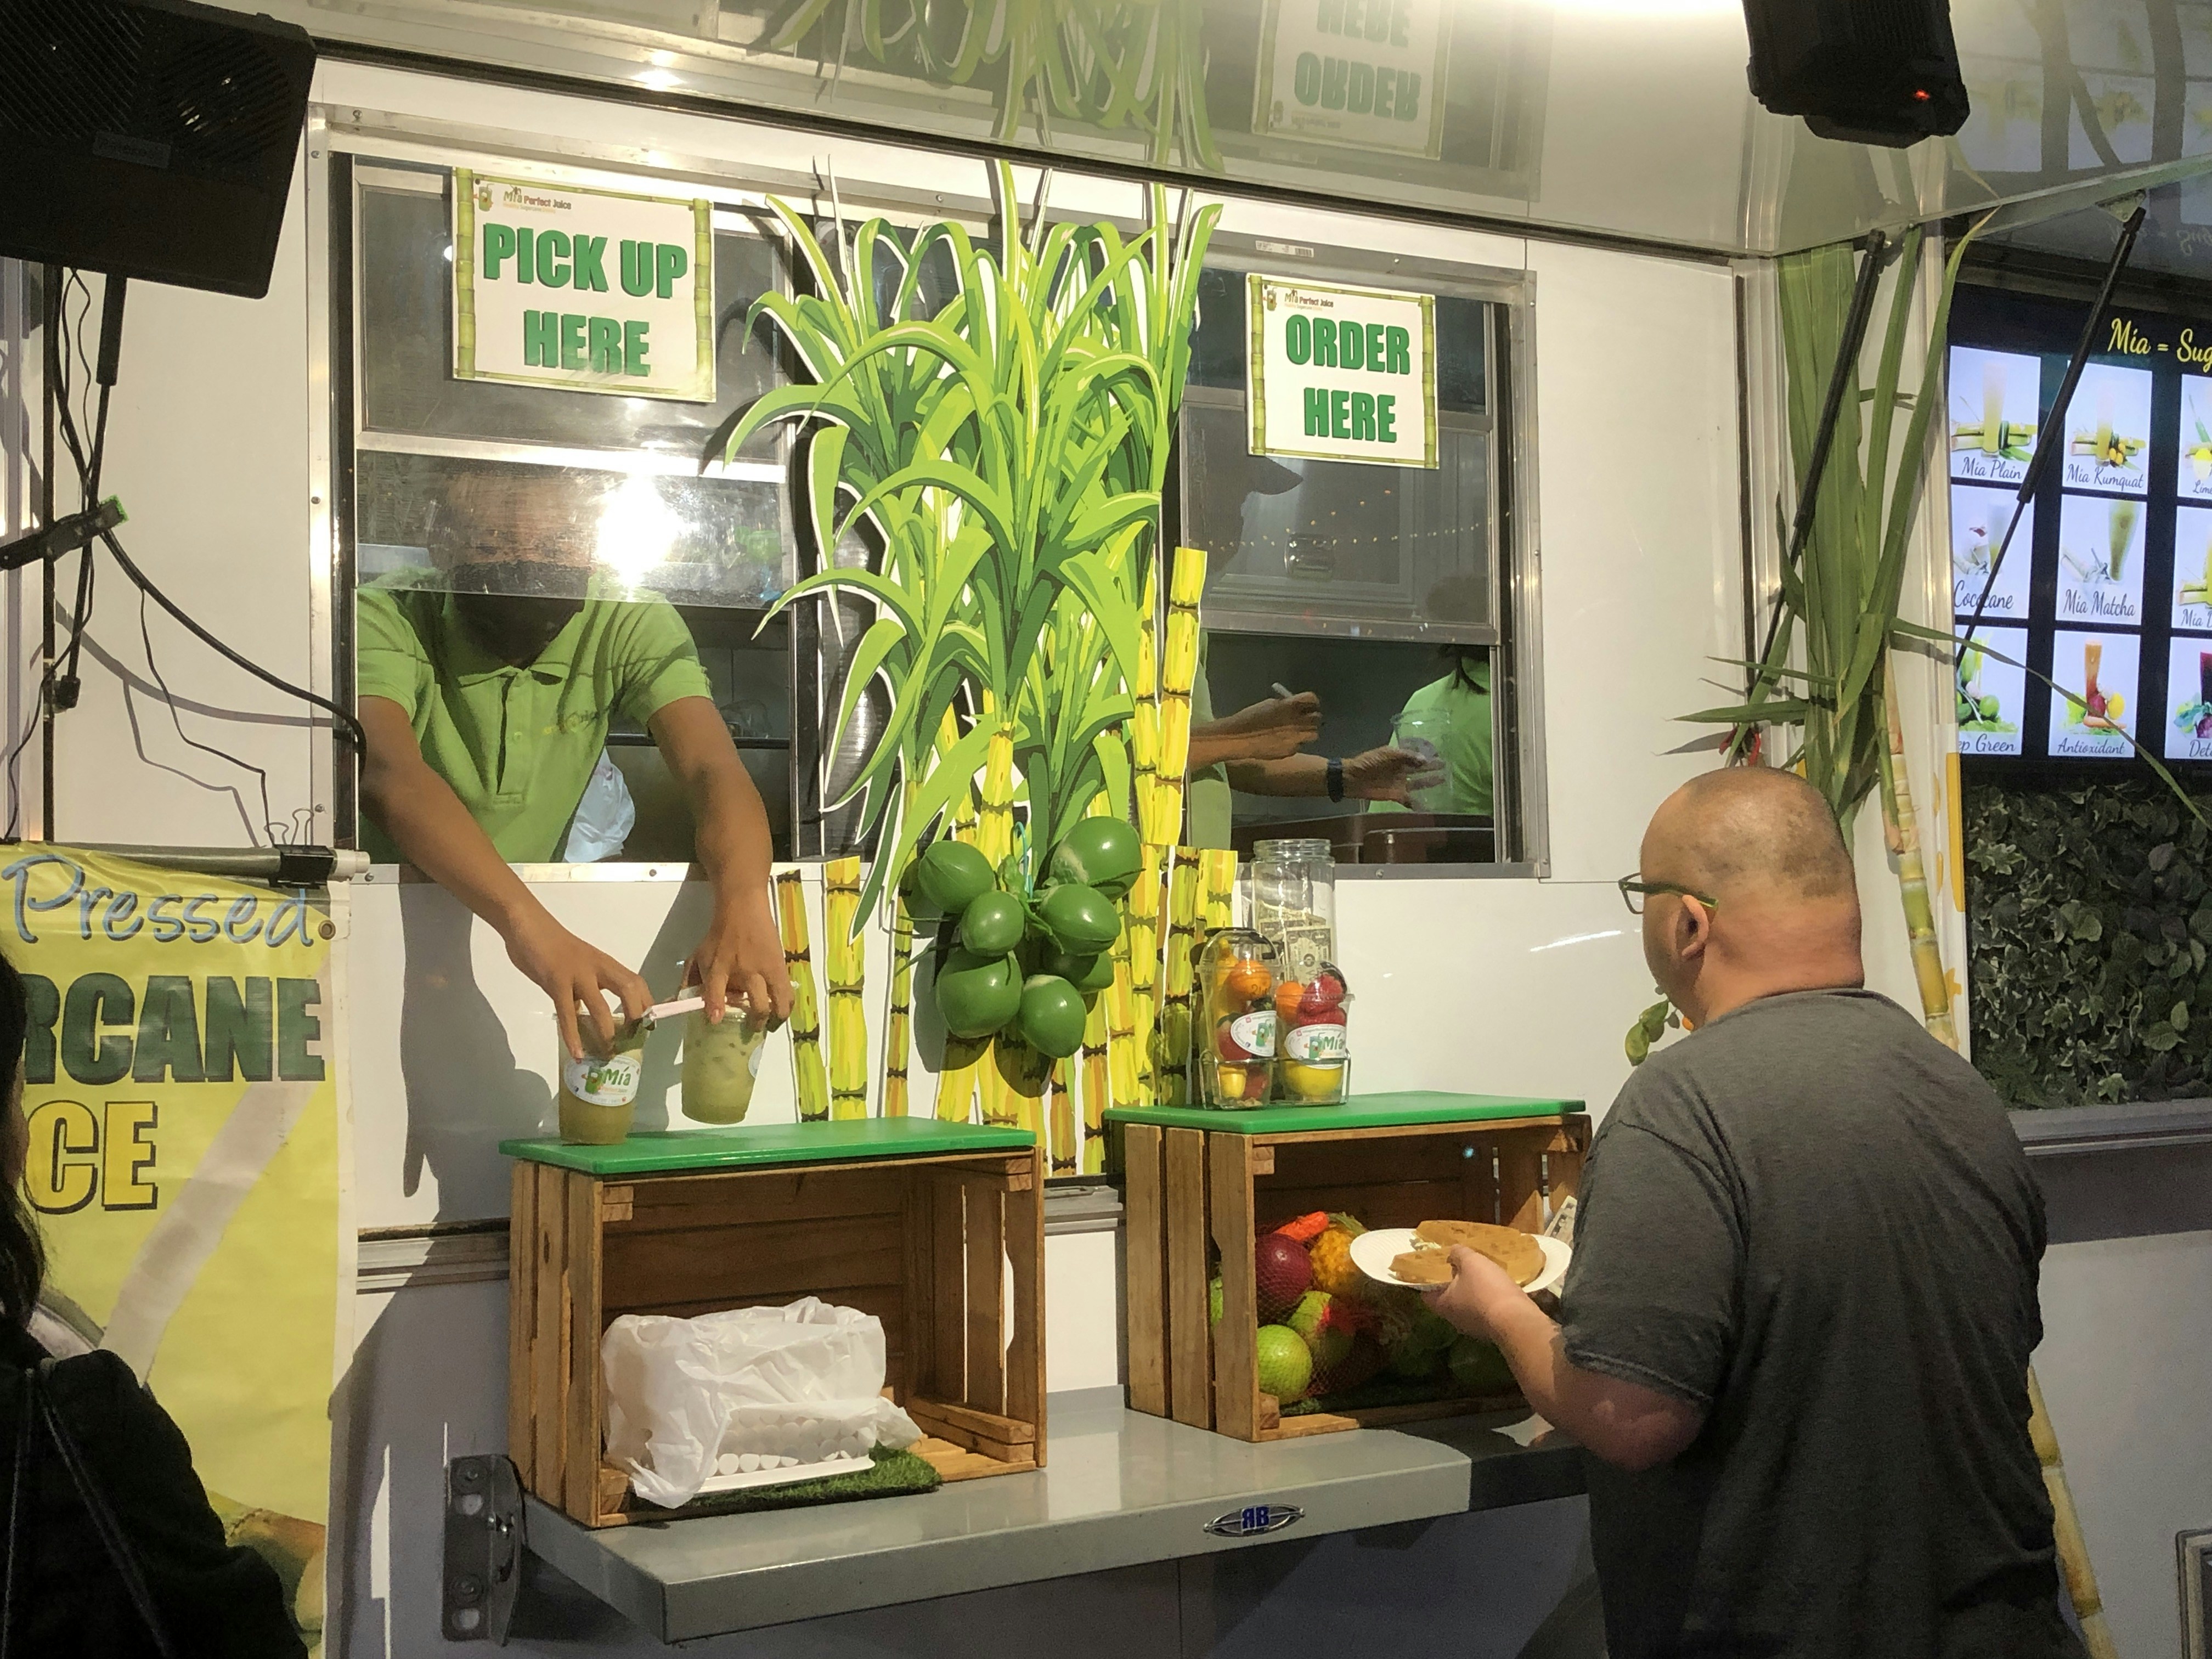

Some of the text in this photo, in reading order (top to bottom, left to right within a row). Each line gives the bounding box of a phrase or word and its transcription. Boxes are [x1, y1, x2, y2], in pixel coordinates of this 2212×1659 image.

[523, 195, 551, 207] Perfect
[552, 199, 572, 210] Juice
[483, 223, 688, 299] PICK UP
[1299, 296, 1319, 306] Perfect
[1320, 298, 1334, 308] Juice
[523, 310, 651, 377] HERE
[1285, 314, 1410, 375] ORDER
[1304, 387, 1397, 443] HERE
[1990, 459, 2023, 479] Plain
[2094, 466, 2144, 492] Kumquat
[2091, 590, 2136, 616] Matcha
[1976, 733, 2016, 752] Green
[2057, 740, 2125, 755] Antioxidant
[1, 854, 314, 948] Pressed
